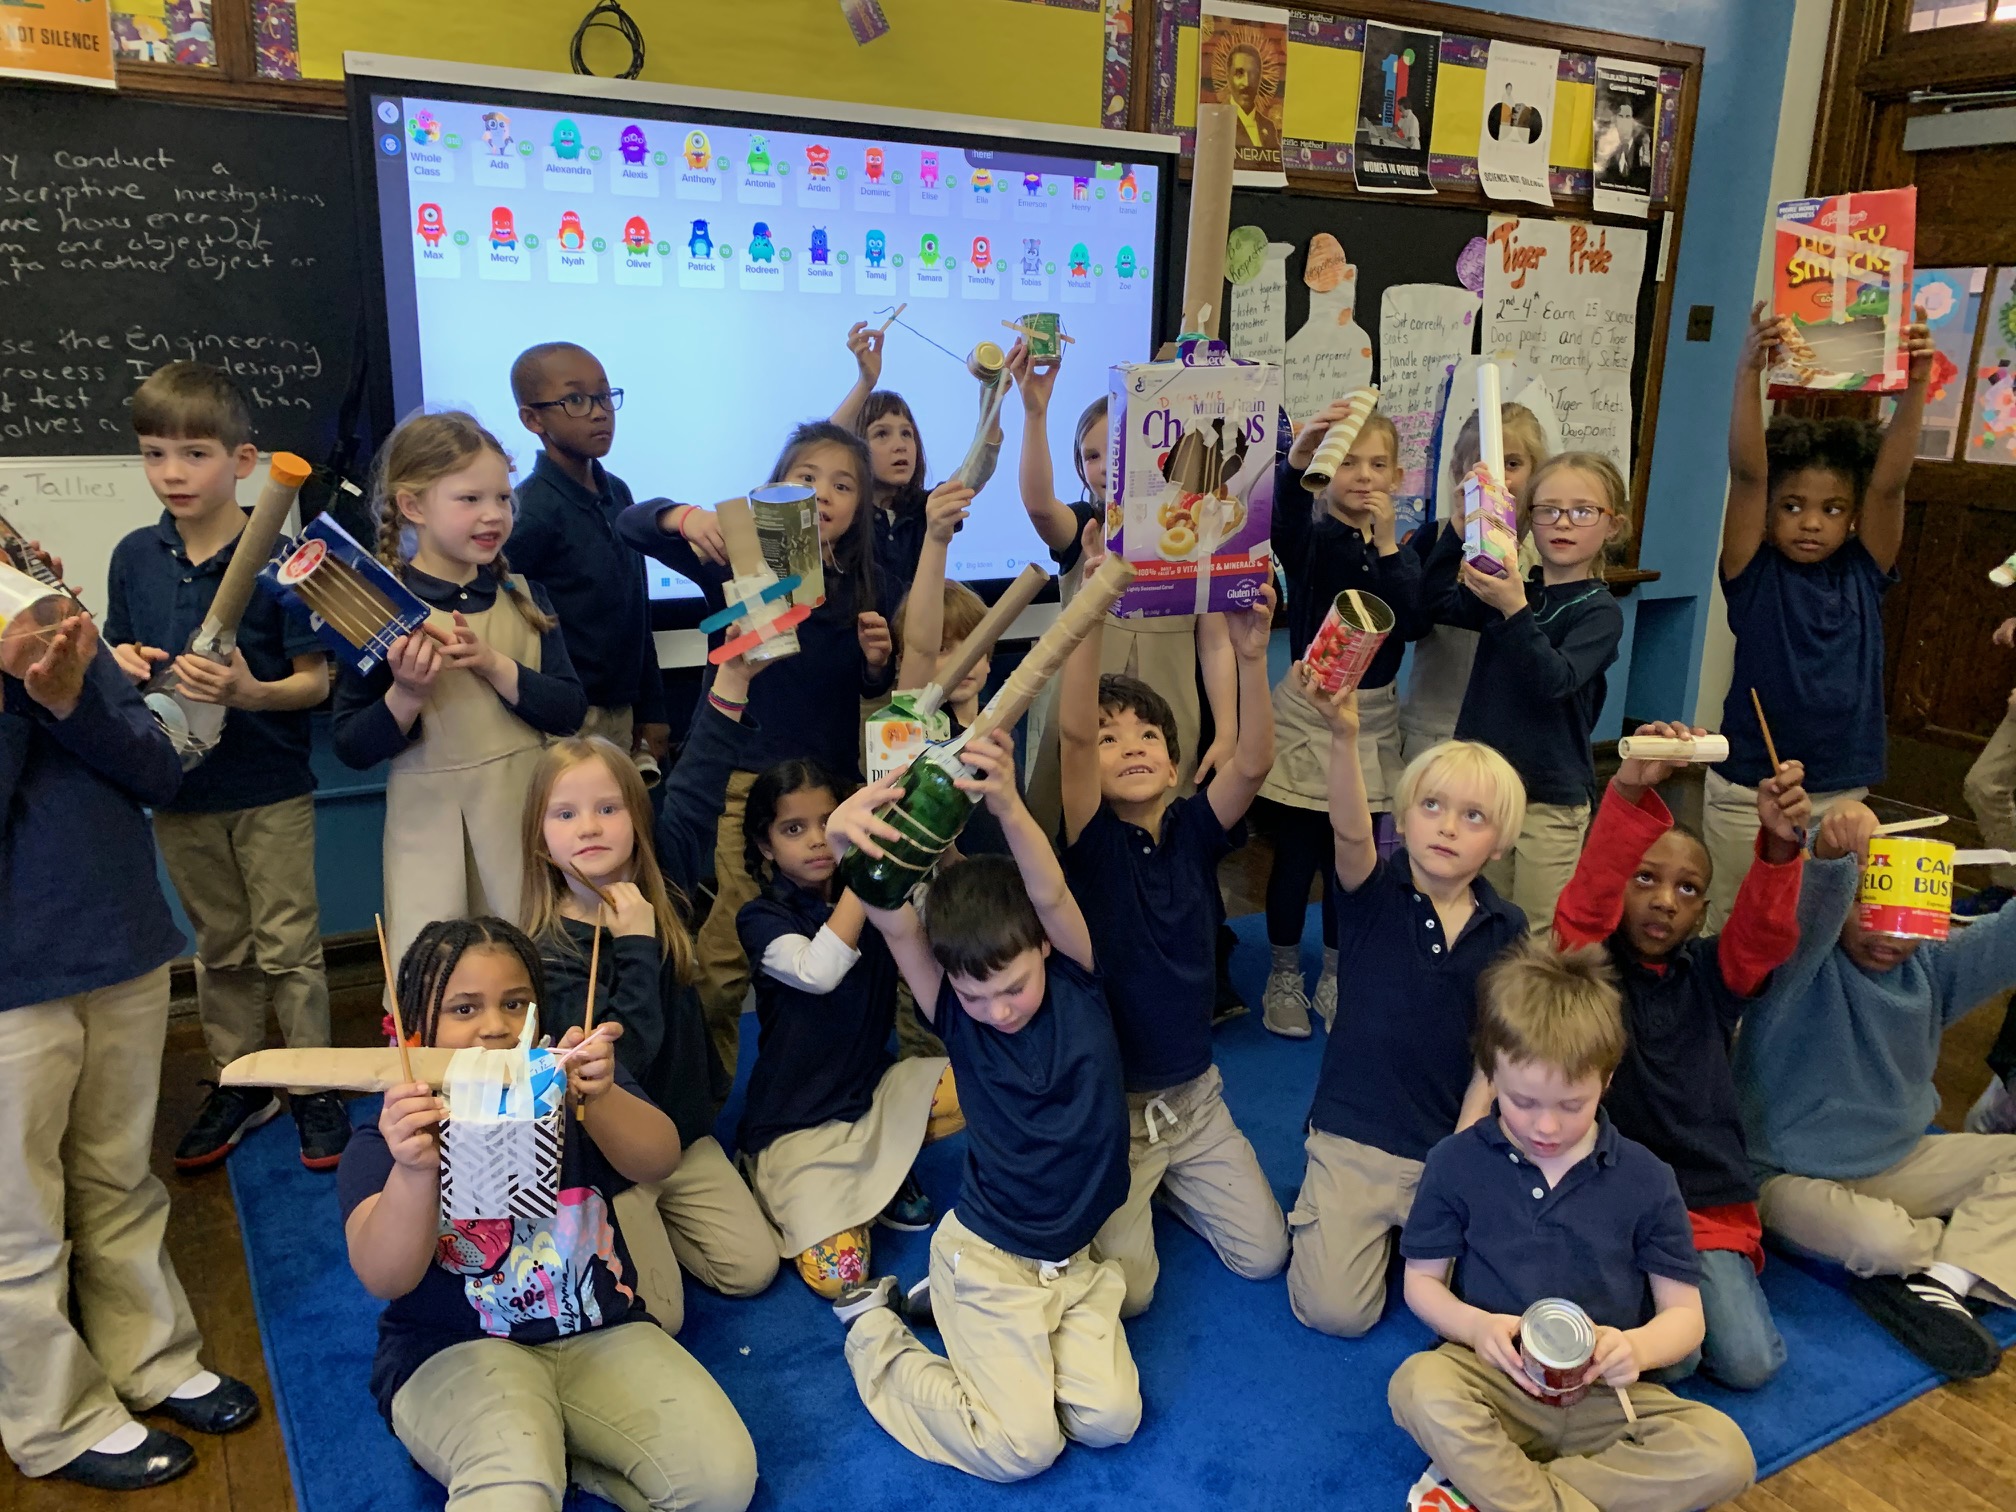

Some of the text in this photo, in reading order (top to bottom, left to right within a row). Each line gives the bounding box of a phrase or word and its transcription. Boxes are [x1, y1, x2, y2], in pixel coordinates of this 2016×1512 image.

[1309, 13, 1334, 24] Method
[41, 28, 100, 52] SILENCE
[1384, 89, 1394, 124] apollo
[411, 152, 442, 163] Whole
[1235, 148, 1281, 163] NERATE
[212, 162, 230, 175] a
[490, 159, 509, 169] Ada
[546, 163, 592, 175] Alexandra
[1363, 160, 1419, 177] WOMEN IN POWER
[414, 166, 441, 177] Class
[622, 169, 648, 179] Alexis
[682, 173, 716, 185] Anthony
[1484, 172, 1510, 183] SCIENCE
[1510, 174, 1521, 183] NOT
[745, 179, 776, 189] Antonia
[808, 183, 831, 193] Arden
[4, 177, 146, 212] scriptive
[861, 187, 891, 197] Dominic
[922, 192, 938, 201] Elise
[1018, 199, 1047, 208] Emerson
[1072, 203, 1091, 212] Henry
[1779, 206, 1797, 214] MORE
[1783, 211, 1815, 219] GOODNESS
[128, 232, 214, 260] object
[424, 250, 444, 260] Max
[491, 253, 519, 264] Mercy
[1488, 219, 1613, 289] Tiger Pride
[61, 255, 166, 273] another
[187, 249, 274, 280] object
[561, 256, 584, 266] Nyah
[626, 259, 651, 269] Oliver
[688, 262, 715, 272] Patrick
[745, 265, 779, 274] Rodreen
[808, 268, 833, 277] Sonika
[866, 271, 887, 281] Tamaj
[917, 273, 943, 282] Tamara
[968, 275, 995, 285] Timothy
[1020, 278, 1042, 287] Tobias
[1067, 280, 1091, 289] Yehudit
[1119, 282, 1131, 290] Zoe
[1543, 301, 1576, 320] Earn
[1410, 315, 1446, 336] correctly
[1559, 329, 1583, 345] and
[2, 325, 322, 377] se the Engineering
[1313, 347, 1352, 372] prepared
[3, 366, 105, 381] rocess
[29, 386, 91, 409] test
[1193, 399, 1225, 414] Multi
[1556, 386, 1624, 422] Tiger Tickets
[3, 416, 120, 438] olves a
[24, 473, 117, 497] Tallies
[966, 560, 976, 570] Big
[1183, 562, 1214, 573] VITAS
[1216, 562, 1222, 571] &
[1224, 560, 1256, 569] MINERALS
[1227, 587, 1262, 599] Gluten Fre
[1864, 873, 1893, 891] ELO
[516, 1222, 538, 1244] L.A.
[561, 1258, 579, 1334] lifornia
